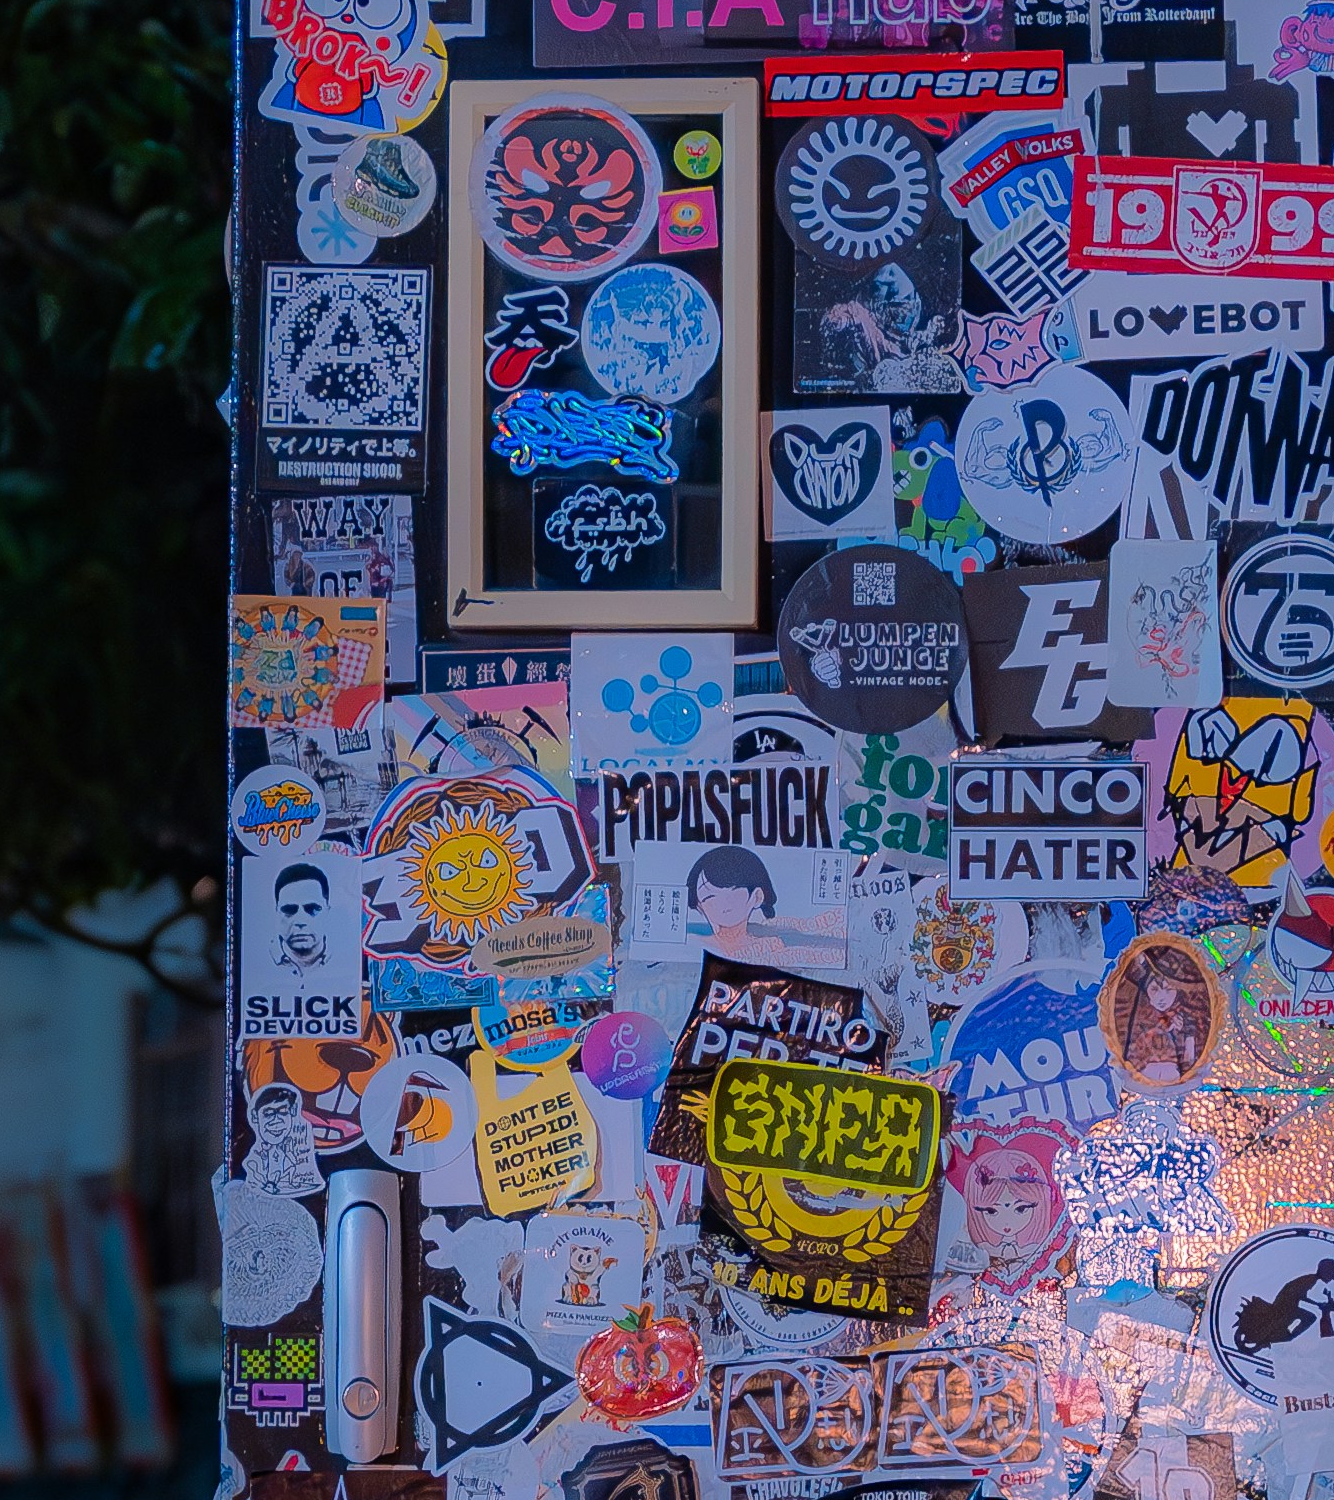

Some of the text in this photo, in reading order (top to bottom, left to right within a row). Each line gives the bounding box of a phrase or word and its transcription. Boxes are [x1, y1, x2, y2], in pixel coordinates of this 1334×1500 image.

[770, 68, 1058, 102] MOTORSPEC
[954, 135, 1074, 199] VALLEY VOLKS
[292, 499, 393, 540] WAY
[838, 622, 959, 647] LUMPEN
[849, 647, 949, 672] JUNGE
[955, 769, 1142, 814] CINCO
[958, 838, 1140, 881] HATER
[527, 928, 563, 951] Coffee
[565, 925, 593, 944] Shop
[244, 1019, 358, 1035] DEVIOUS
[245, 995, 357, 1018] SLICK
[702, 980, 876, 1053] PARTIRO
[968, 1025, 1107, 1099] MOU
[541, 1091, 574, 1116] BE
[490, 1110, 579, 1155] STUPID!
[494, 1132, 585, 1174] MOTHER
[748, 1268, 807, 1300] ANS
[813, 1273, 888, 1313] DÉJÀ
